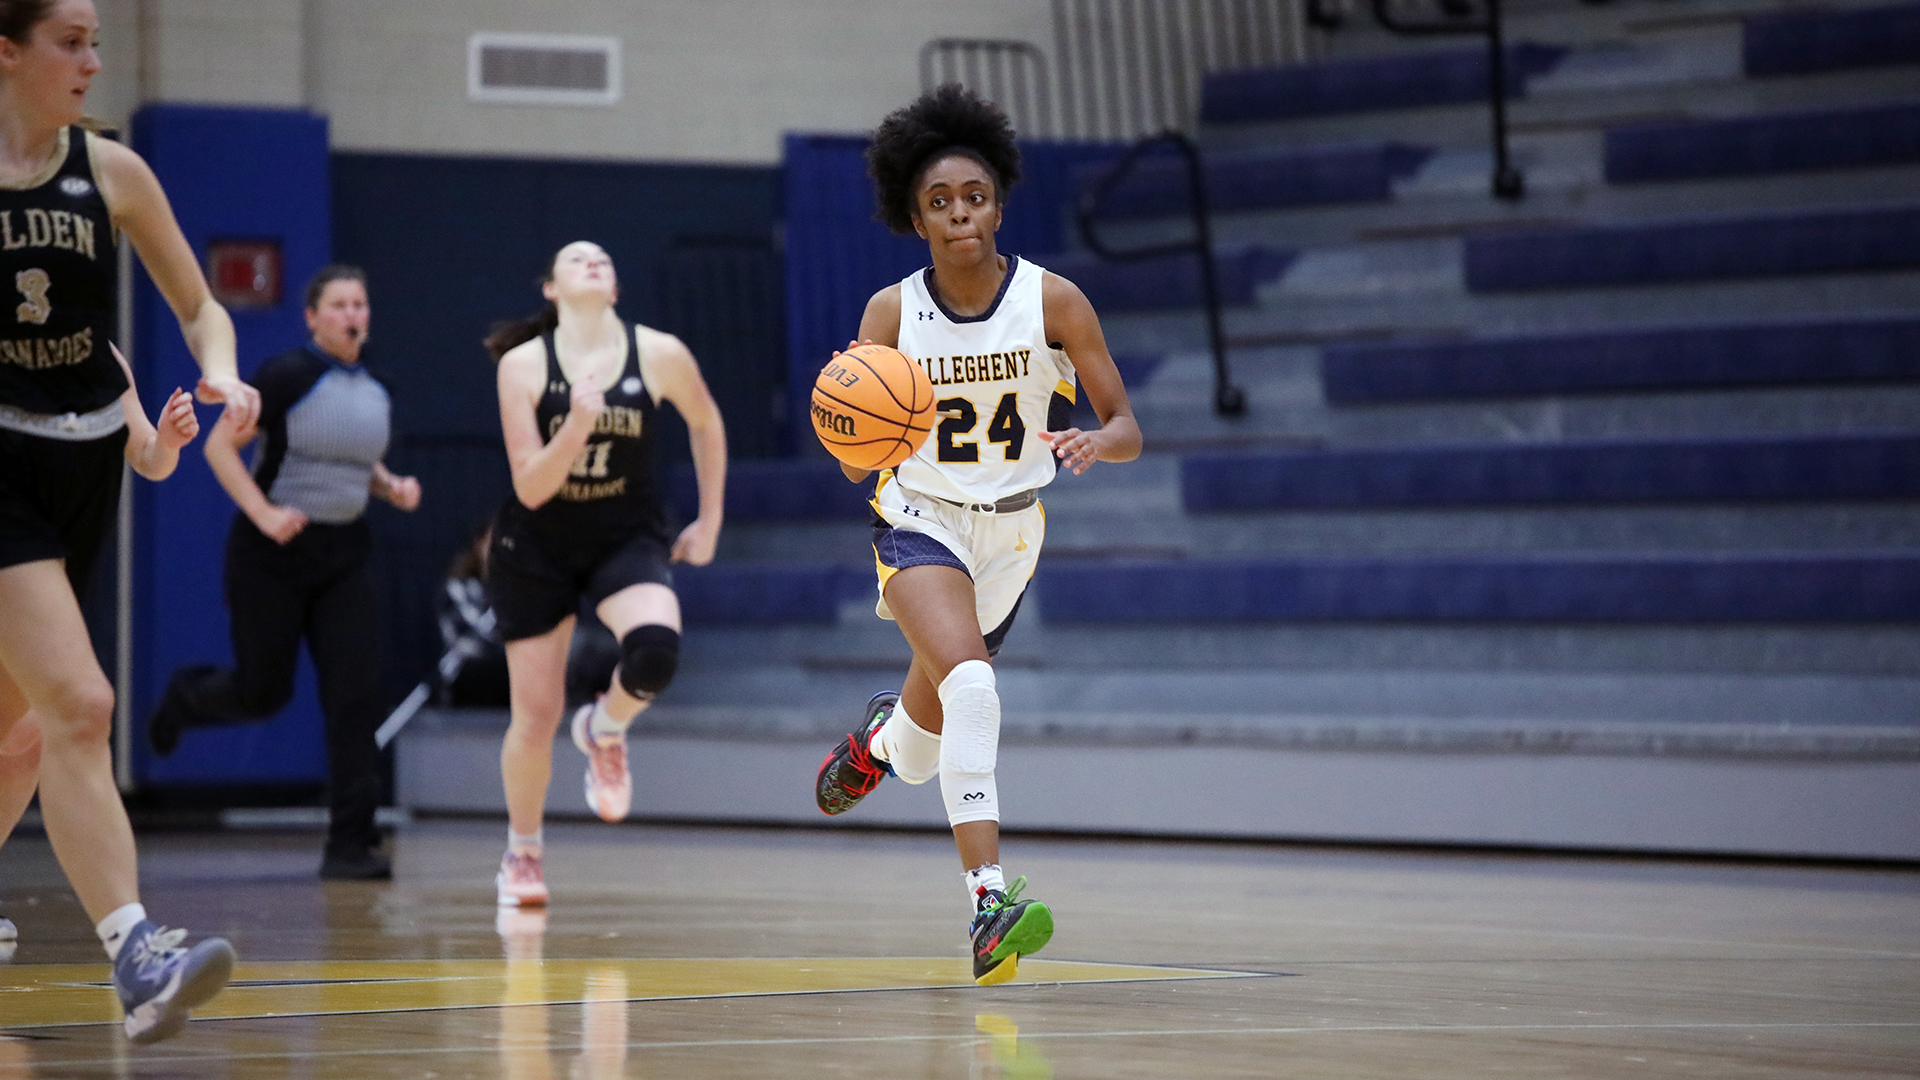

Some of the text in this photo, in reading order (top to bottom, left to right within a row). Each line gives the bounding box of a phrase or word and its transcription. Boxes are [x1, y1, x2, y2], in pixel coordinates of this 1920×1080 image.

[15, 267, 52, 325] 3
[548, 405, 643, 438] GDEN
[810, 400, 858, 437] Wilso
[935, 390, 1027, 465] 24
